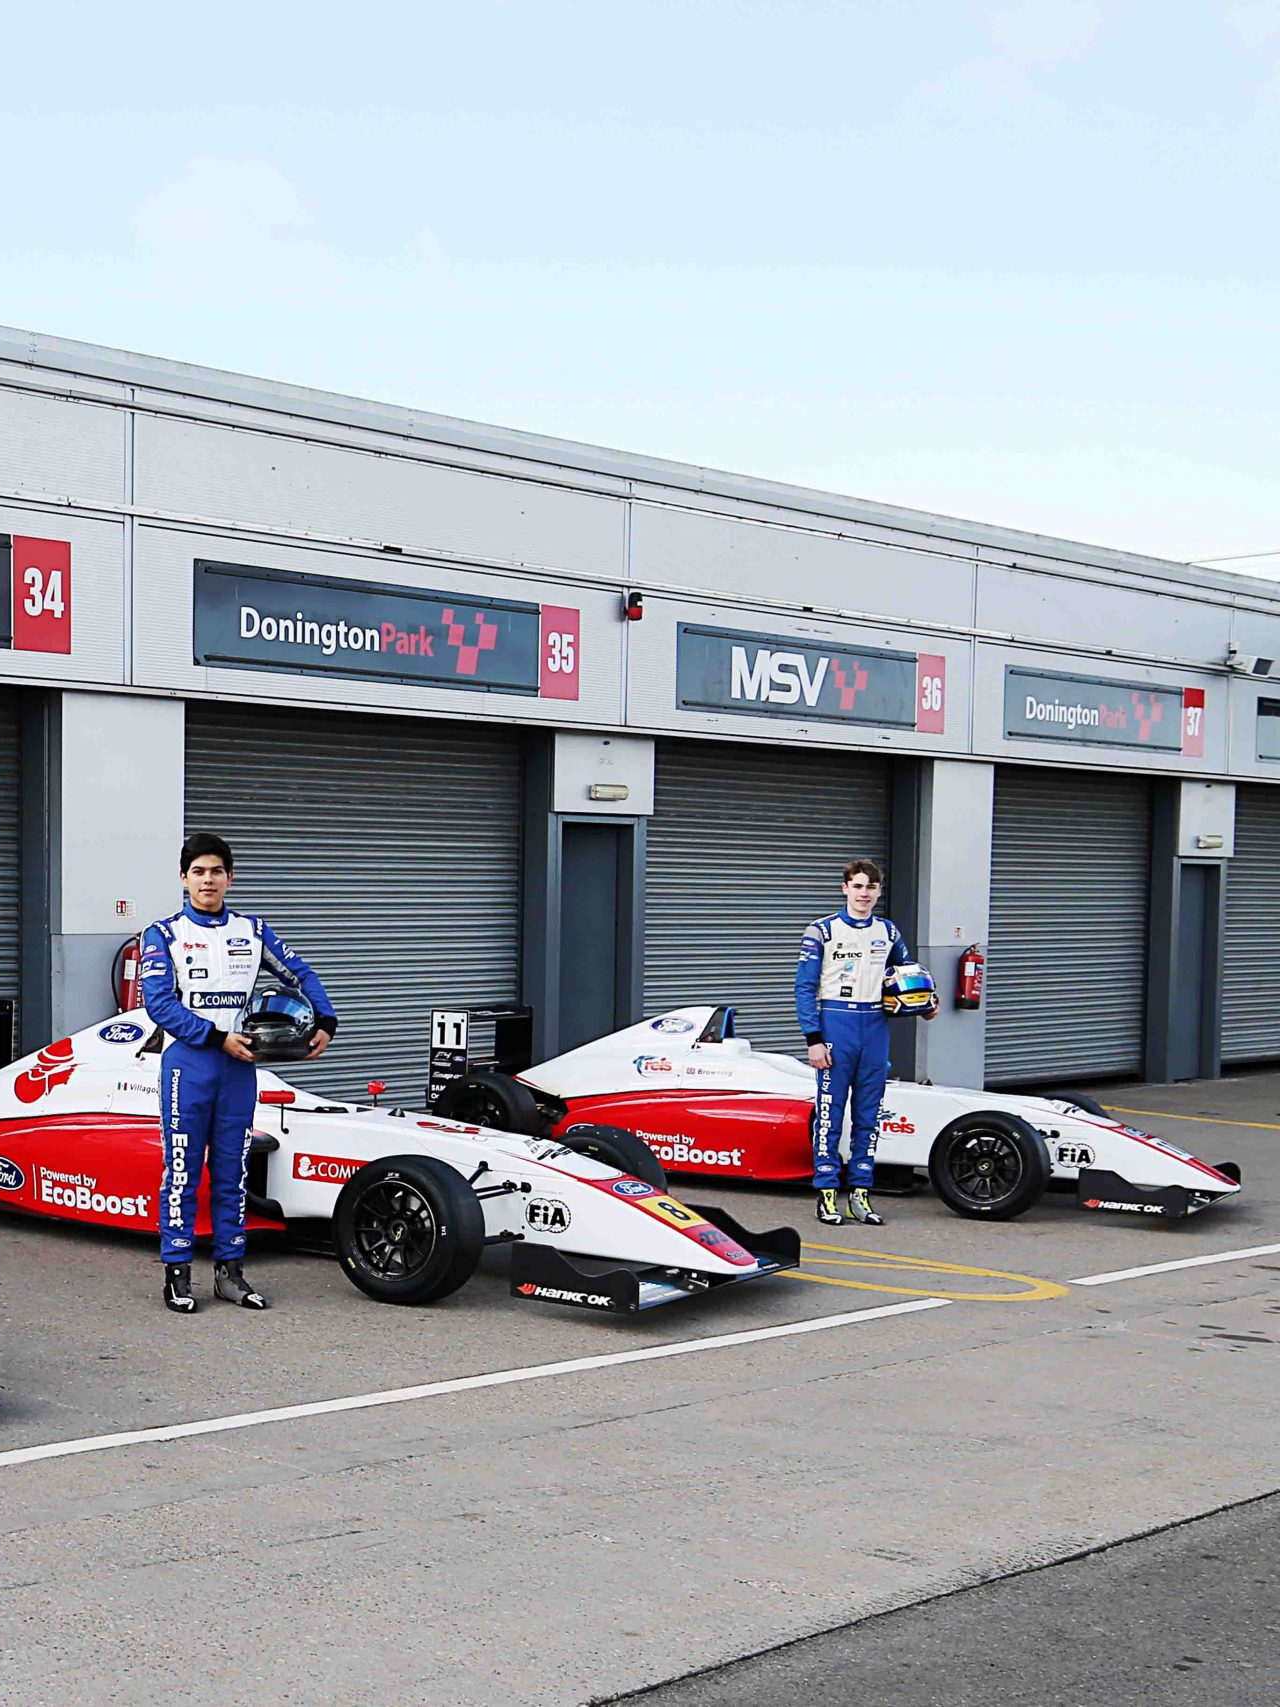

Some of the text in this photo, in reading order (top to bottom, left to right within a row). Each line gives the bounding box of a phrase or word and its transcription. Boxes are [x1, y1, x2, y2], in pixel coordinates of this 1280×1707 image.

[23, 567, 64, 619] 34
[547, 632, 574, 674] 35
[730, 646, 830, 707] MSV
[921, 675, 942, 712] 36
[1186, 706, 1200, 736] 37
[832, 951, 863, 960] fortec
[205, 995, 246, 1006] COMINVI
[105, 1022, 143, 1042] Ford
[437, 1021, 462, 1046] 11
[645, 1057, 673, 1072] reis
[171, 1068, 182, 1118] Powered
[170, 1119, 180, 1131] by
[882, 1116, 916, 1134] reis
[635, 1129, 696, 1146] Powered by
[40, 1166, 97, 1189] Powered by
[618, 1182, 650, 1194] Ford
[41, 1178, 149, 1217] EcoBoost
[657, 1201, 691, 1221] 8
